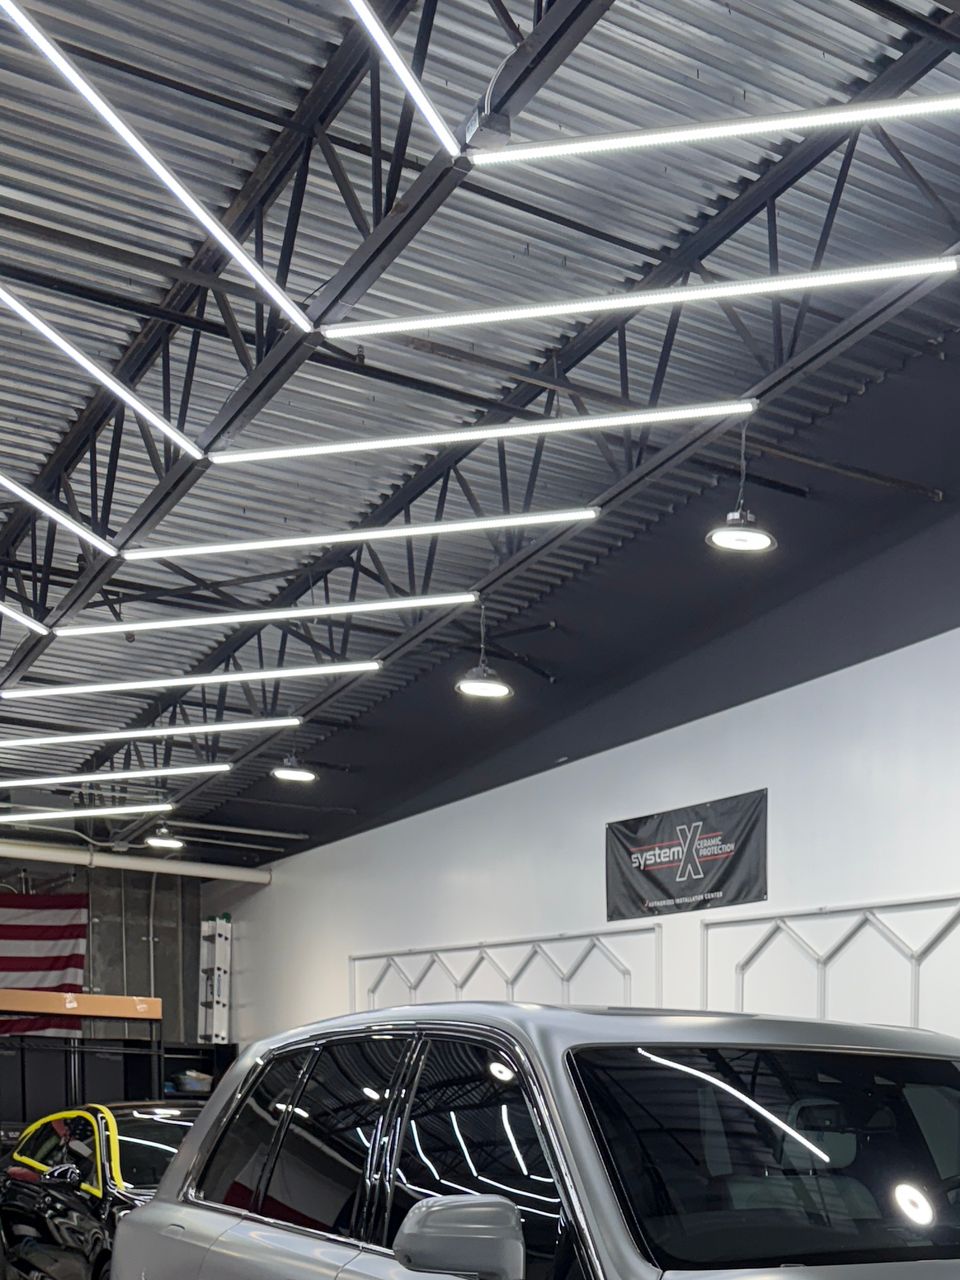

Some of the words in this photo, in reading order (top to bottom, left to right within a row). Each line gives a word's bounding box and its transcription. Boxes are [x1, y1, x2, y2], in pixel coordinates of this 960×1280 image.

[697, 837, 721, 848] CERAMIC
[699, 843, 734, 856] PROTECTION
[704, 891, 723, 899] CENTER
